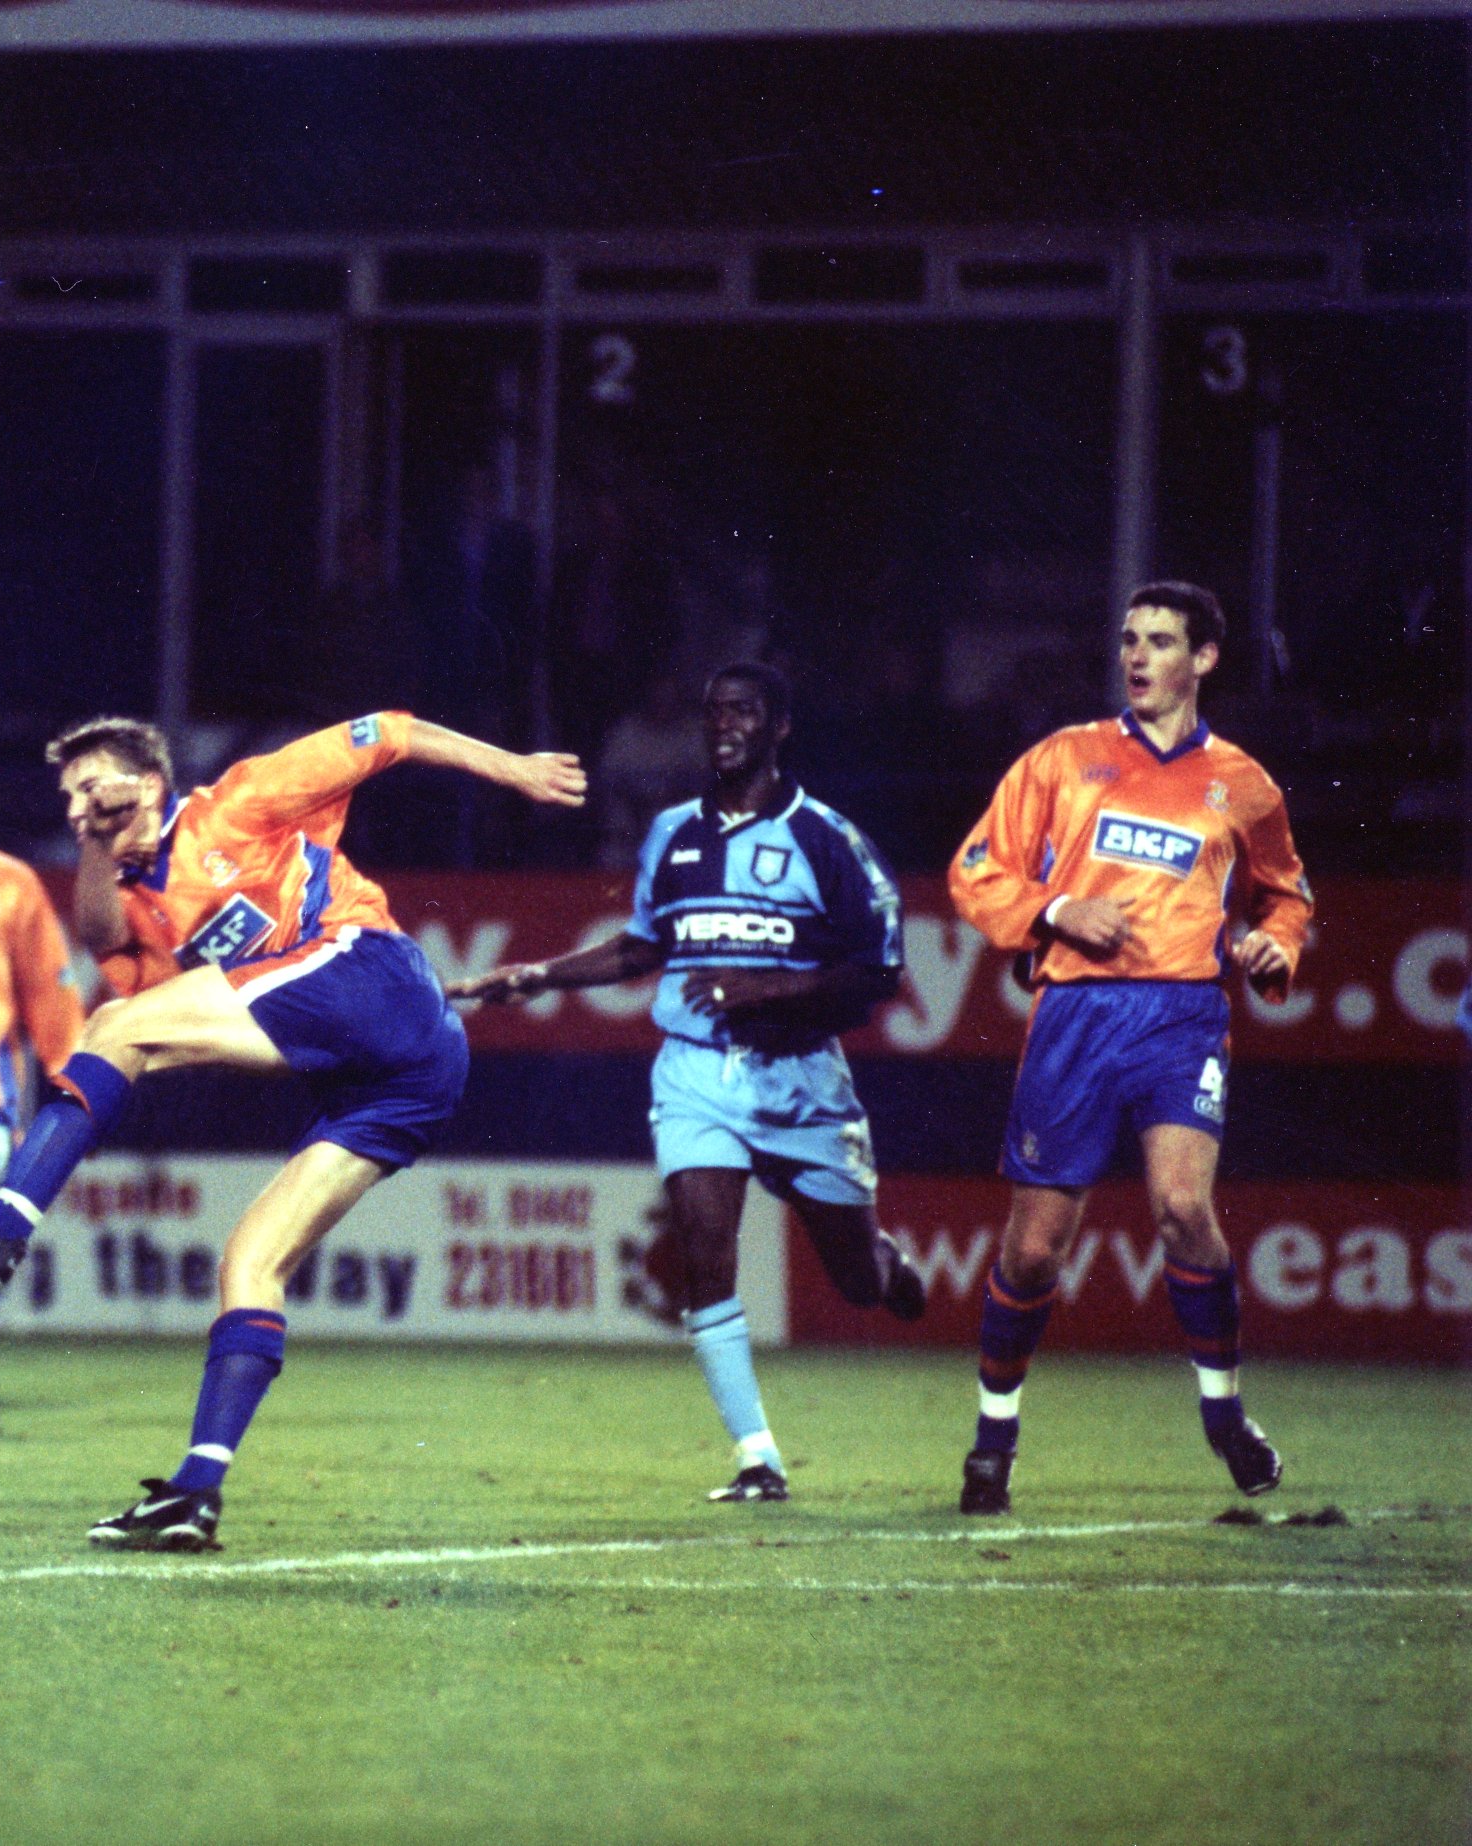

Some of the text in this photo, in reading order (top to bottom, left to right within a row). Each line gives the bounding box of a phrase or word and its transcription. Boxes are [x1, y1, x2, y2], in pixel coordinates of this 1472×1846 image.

[592, 336, 633, 402] 2
[1203, 327, 1246, 392] 3
[1103, 823, 1193, 860] SKF
[198, 910, 245, 964] KF
[673, 913, 795, 944] VERCO
[1199, 1056, 1223, 1102] 4
